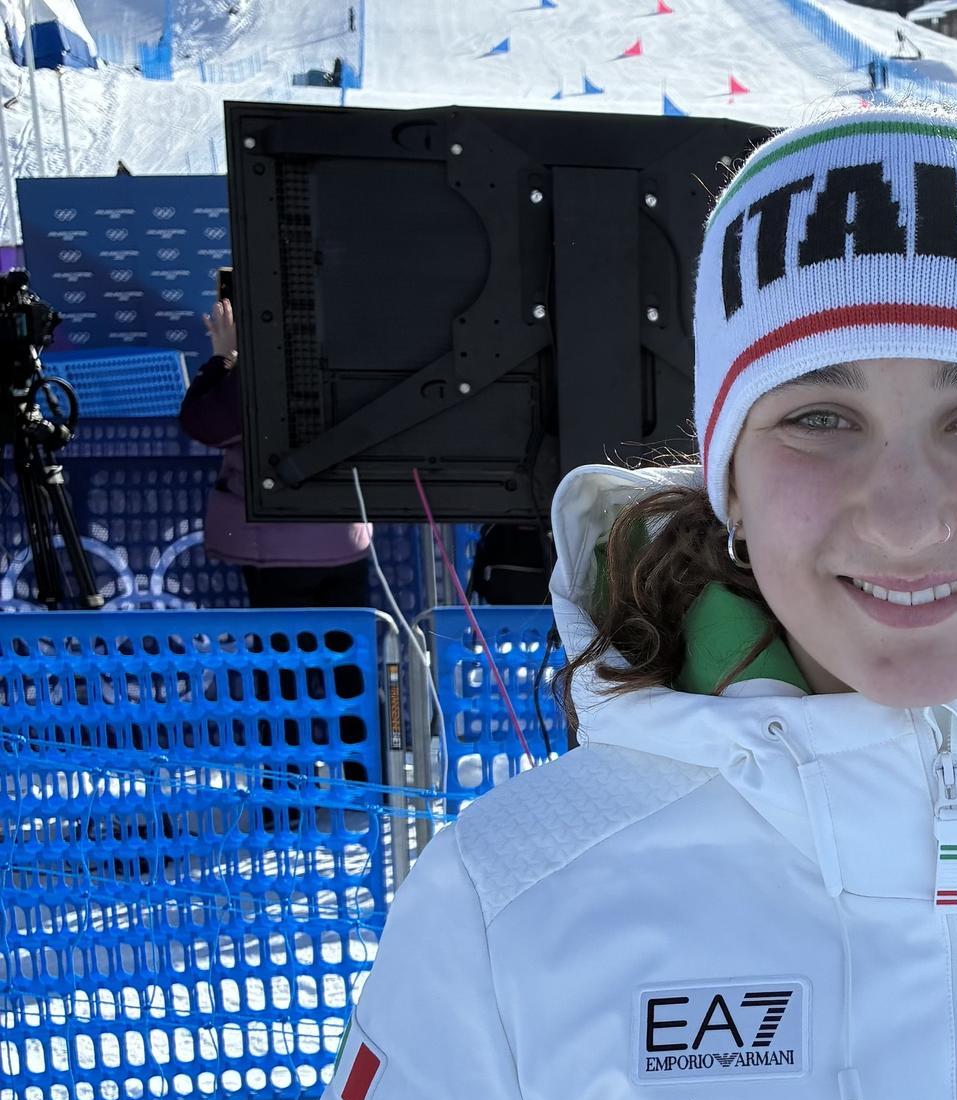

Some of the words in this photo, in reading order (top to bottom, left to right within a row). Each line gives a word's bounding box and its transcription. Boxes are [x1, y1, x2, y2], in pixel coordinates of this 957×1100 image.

[646, 990, 793, 1052] EA7
[645, 1053, 714, 1072] EMPORIO
[736, 1049, 795, 1067] ARMANI
